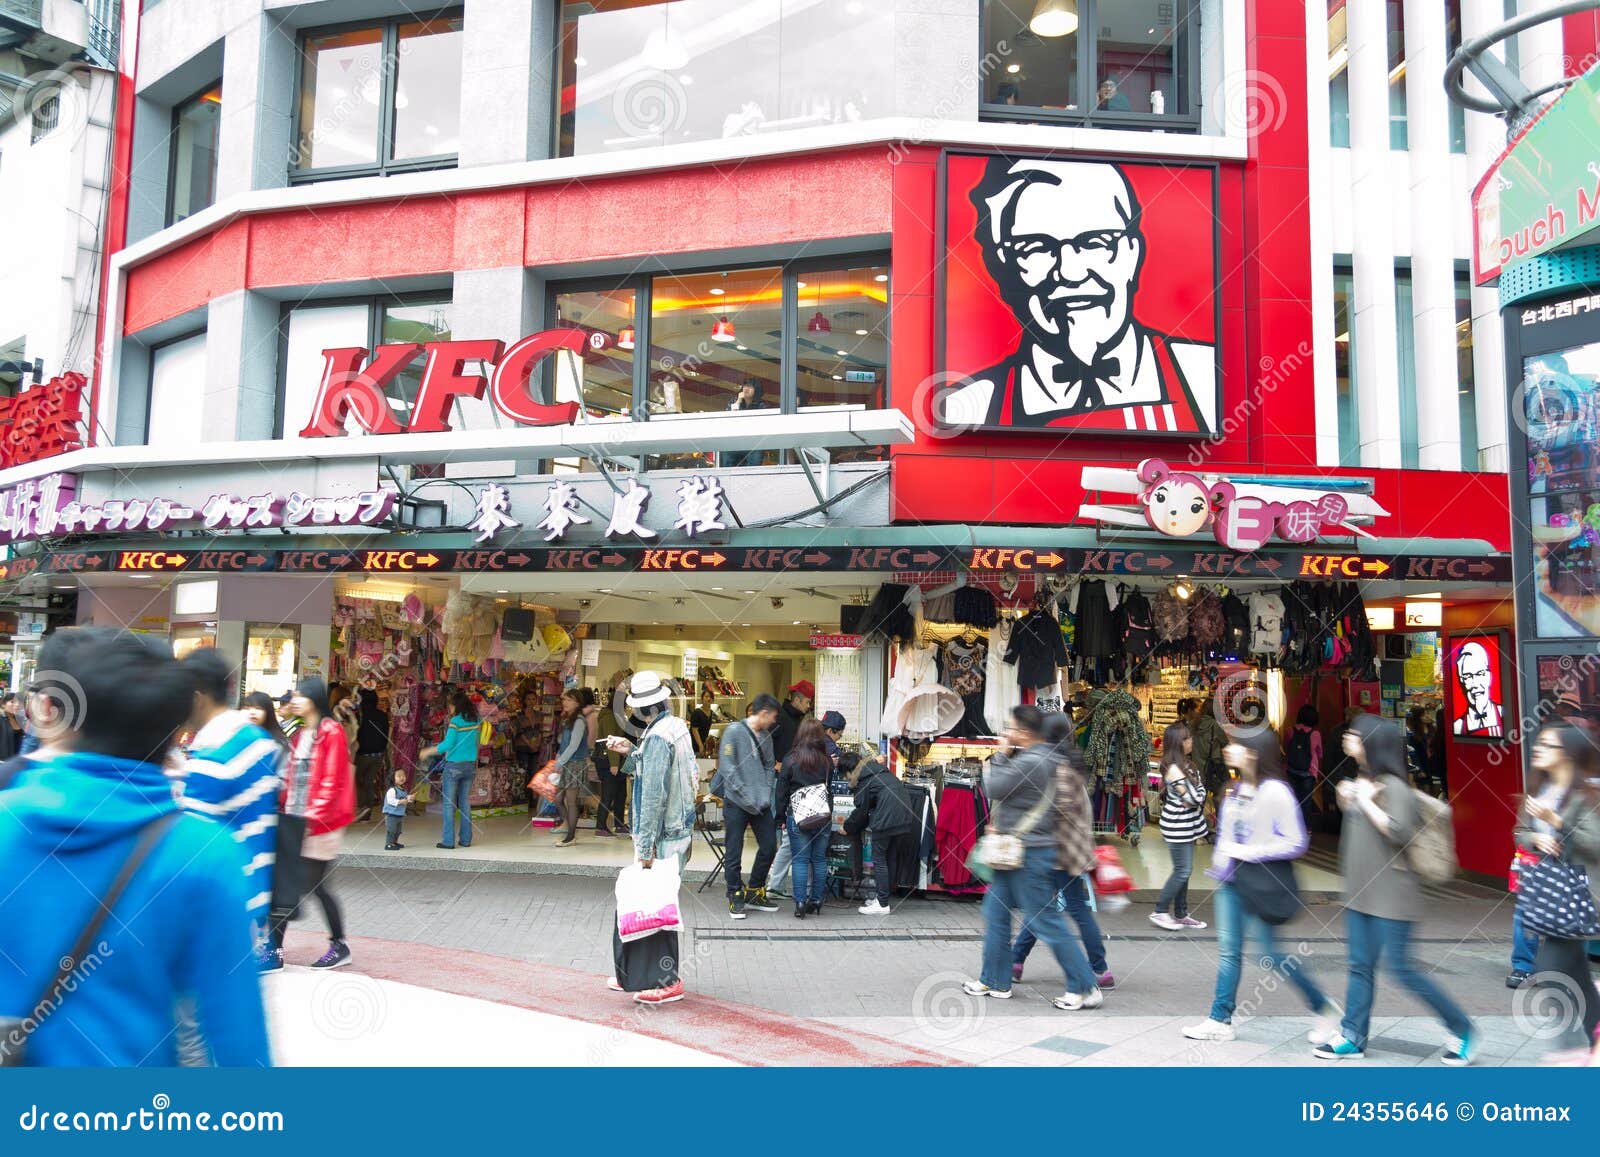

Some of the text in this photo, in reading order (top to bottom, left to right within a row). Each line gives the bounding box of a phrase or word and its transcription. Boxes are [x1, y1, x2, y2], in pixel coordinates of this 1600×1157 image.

[299, 328, 588, 438] KFC
[60, 500, 194, 531] キャラクター
[202, 494, 274, 527] グッズ
[287, 490, 387, 523] ショップ
[49, 553, 87, 570] KFC
[118, 552, 167, 569] KFC
[198, 551, 246, 569] KFC
[279, 551, 329, 569] KFC
[364, 551, 416, 569] KFC
[454, 550, 507, 569] KFC
[545, 550, 600, 569] KFC
[641, 550, 699, 569] KFC
[742, 549, 802, 569] KFC
[849, 549, 911, 569] KFC
[969, 549, 1034, 569] KFC
[1083, 552, 1146, 572] KFC
[1191, 553, 1252, 573] KFC
[1300, 555, 1361, 576] KFC
[1407, 557, 1467, 578] KFC
[1406, 614, 1424, 624] FC
